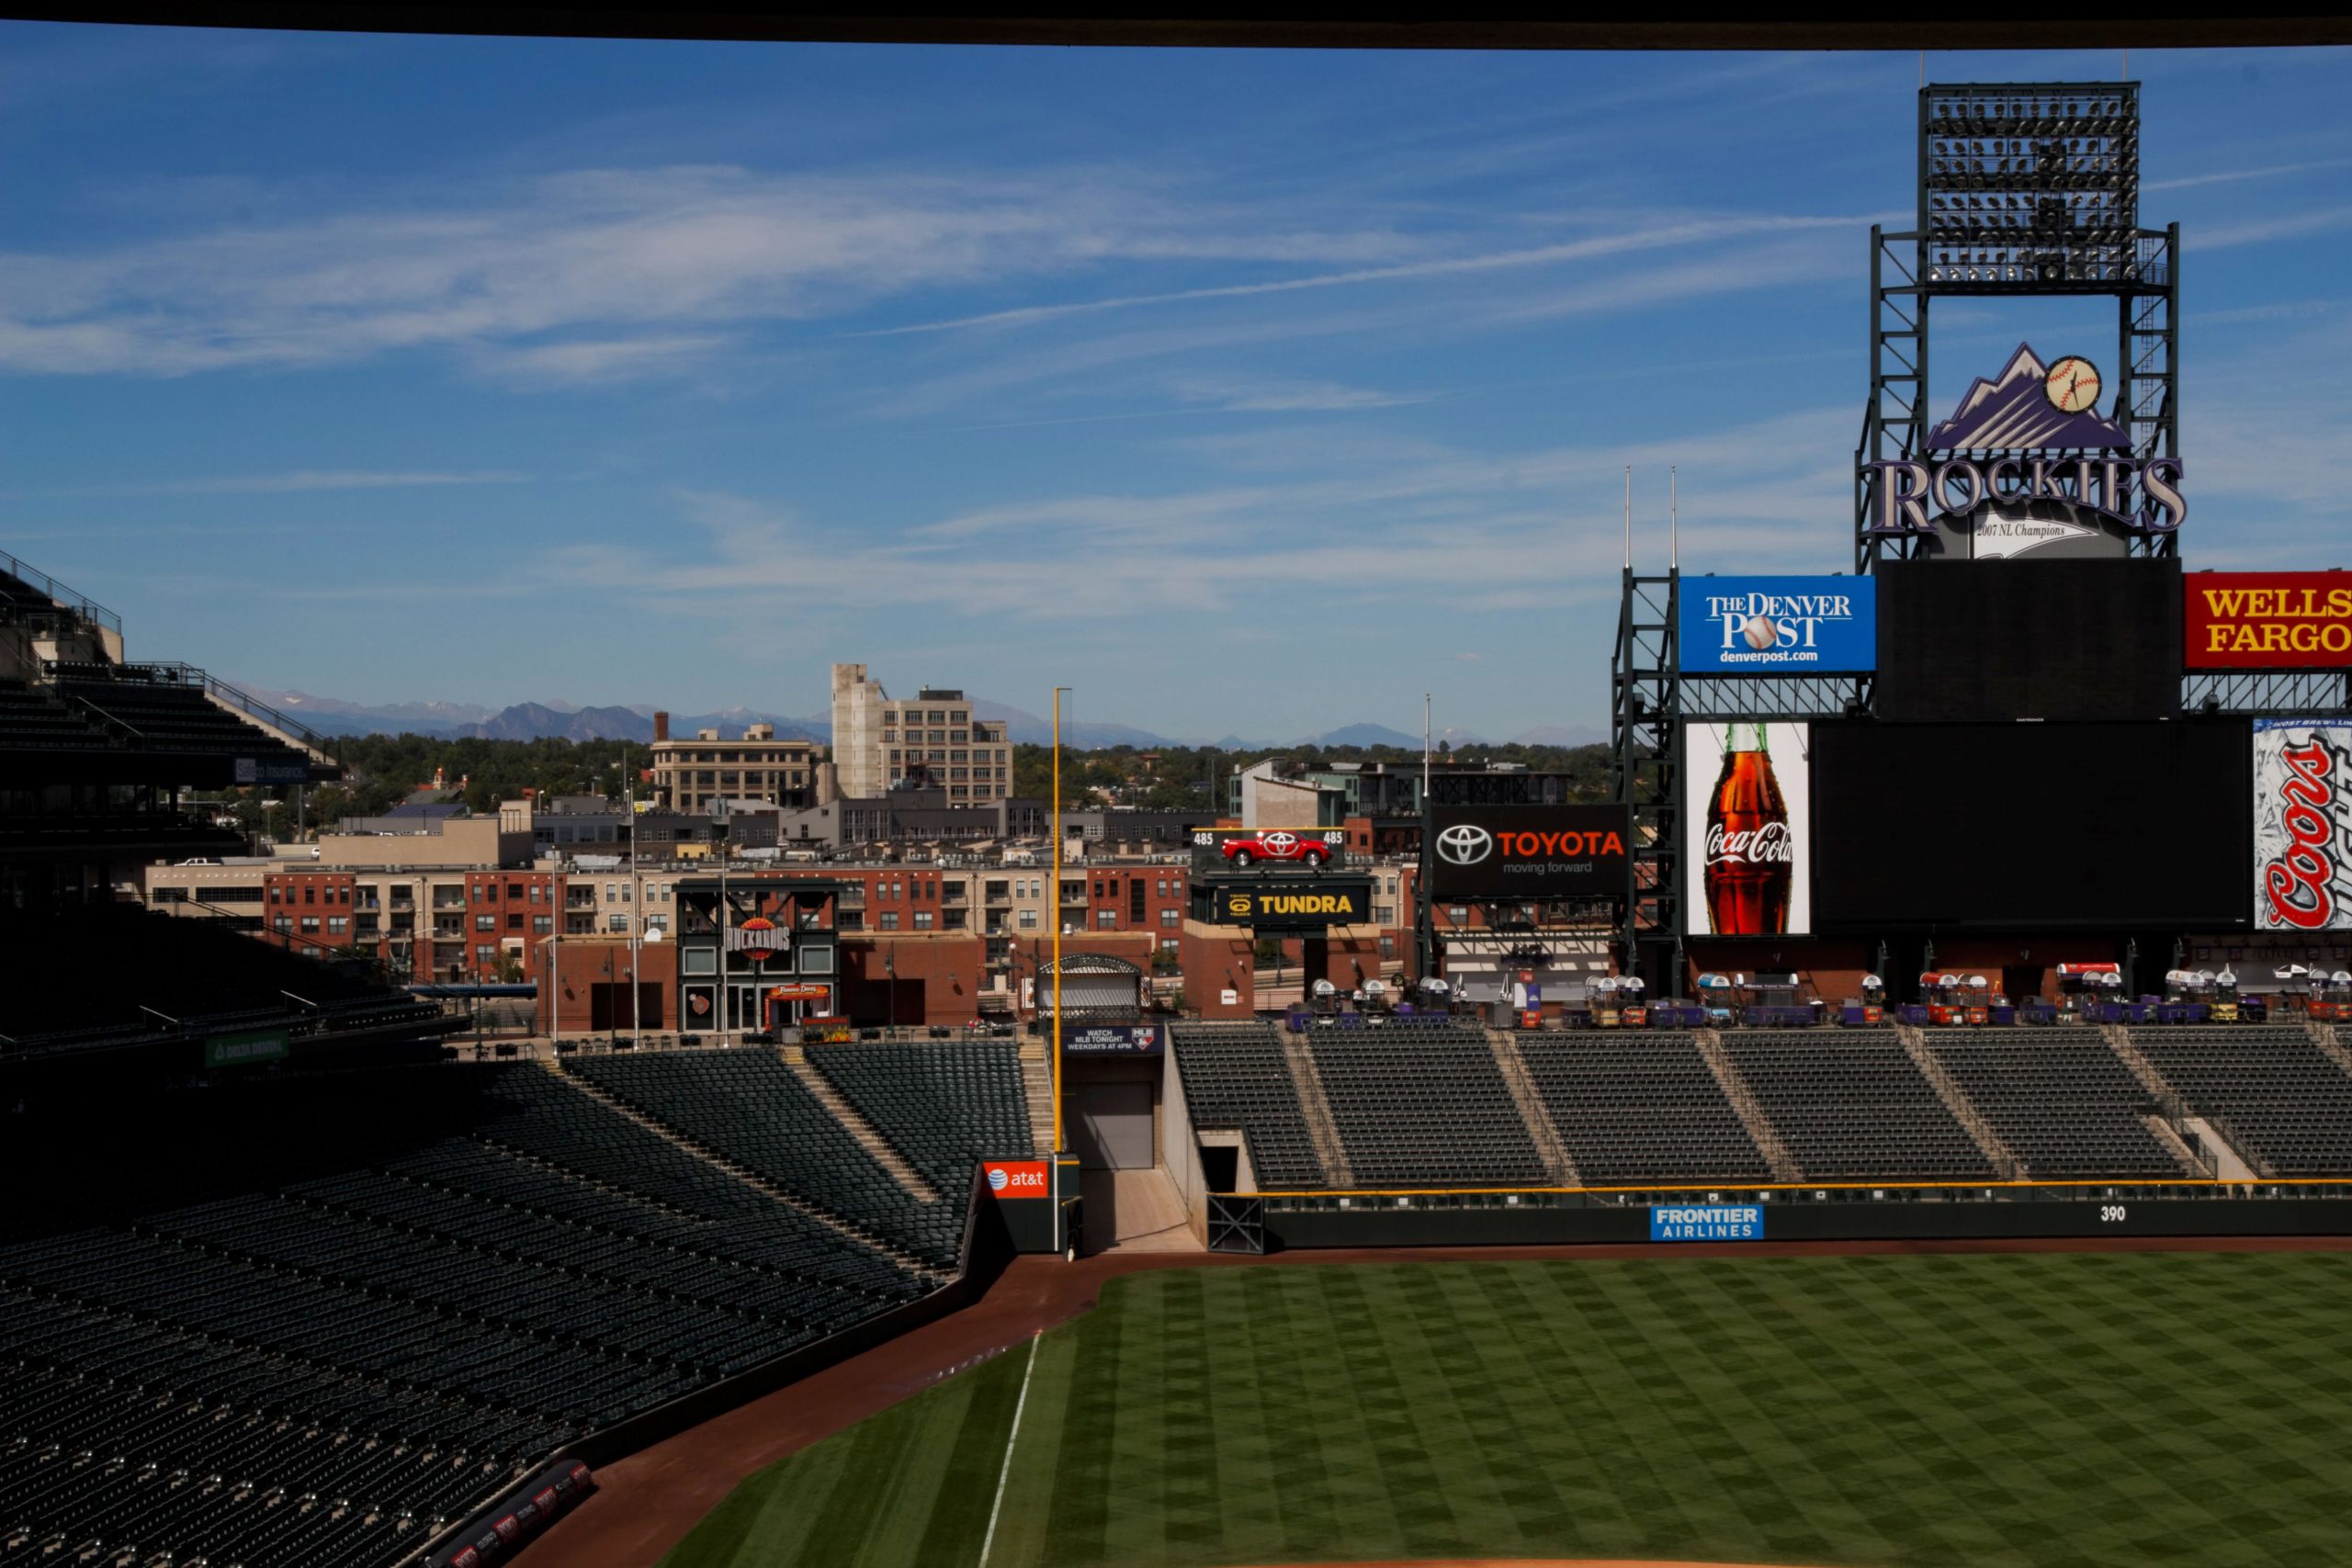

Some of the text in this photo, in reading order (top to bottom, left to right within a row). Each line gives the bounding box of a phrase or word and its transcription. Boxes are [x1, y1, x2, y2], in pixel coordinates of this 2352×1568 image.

[1871, 457, 2187, 533] ROCKIES
[1977, 524, 2064, 539] 2007 NL Champions
[1705, 592, 1852, 618] THE DENVER
[2202, 588, 2352, 618] WELLS
[2205, 624, 2352, 652] FARGO
[1720, 650, 1818, 663] denverpost.com
[237, 761, 265, 779] Safeco
[1194, 832, 1213, 845] 485
[1323, 830, 1343, 844] 485
[2266, 734, 2335, 929] Coors
[1497, 831, 1624, 857] TOYOTA
[1704, 821, 1792, 866] Coca-Cola
[1503, 861, 1592, 875] moving forward
[1259, 895, 1352, 914] TUNDRA
[1011, 1170, 1044, 1187] at&t
[1657, 1208, 1758, 1224] FRONTIER
[2100, 1205, 2126, 1222] 390
[1662, 1224, 1752, 1238] AIRLINES
